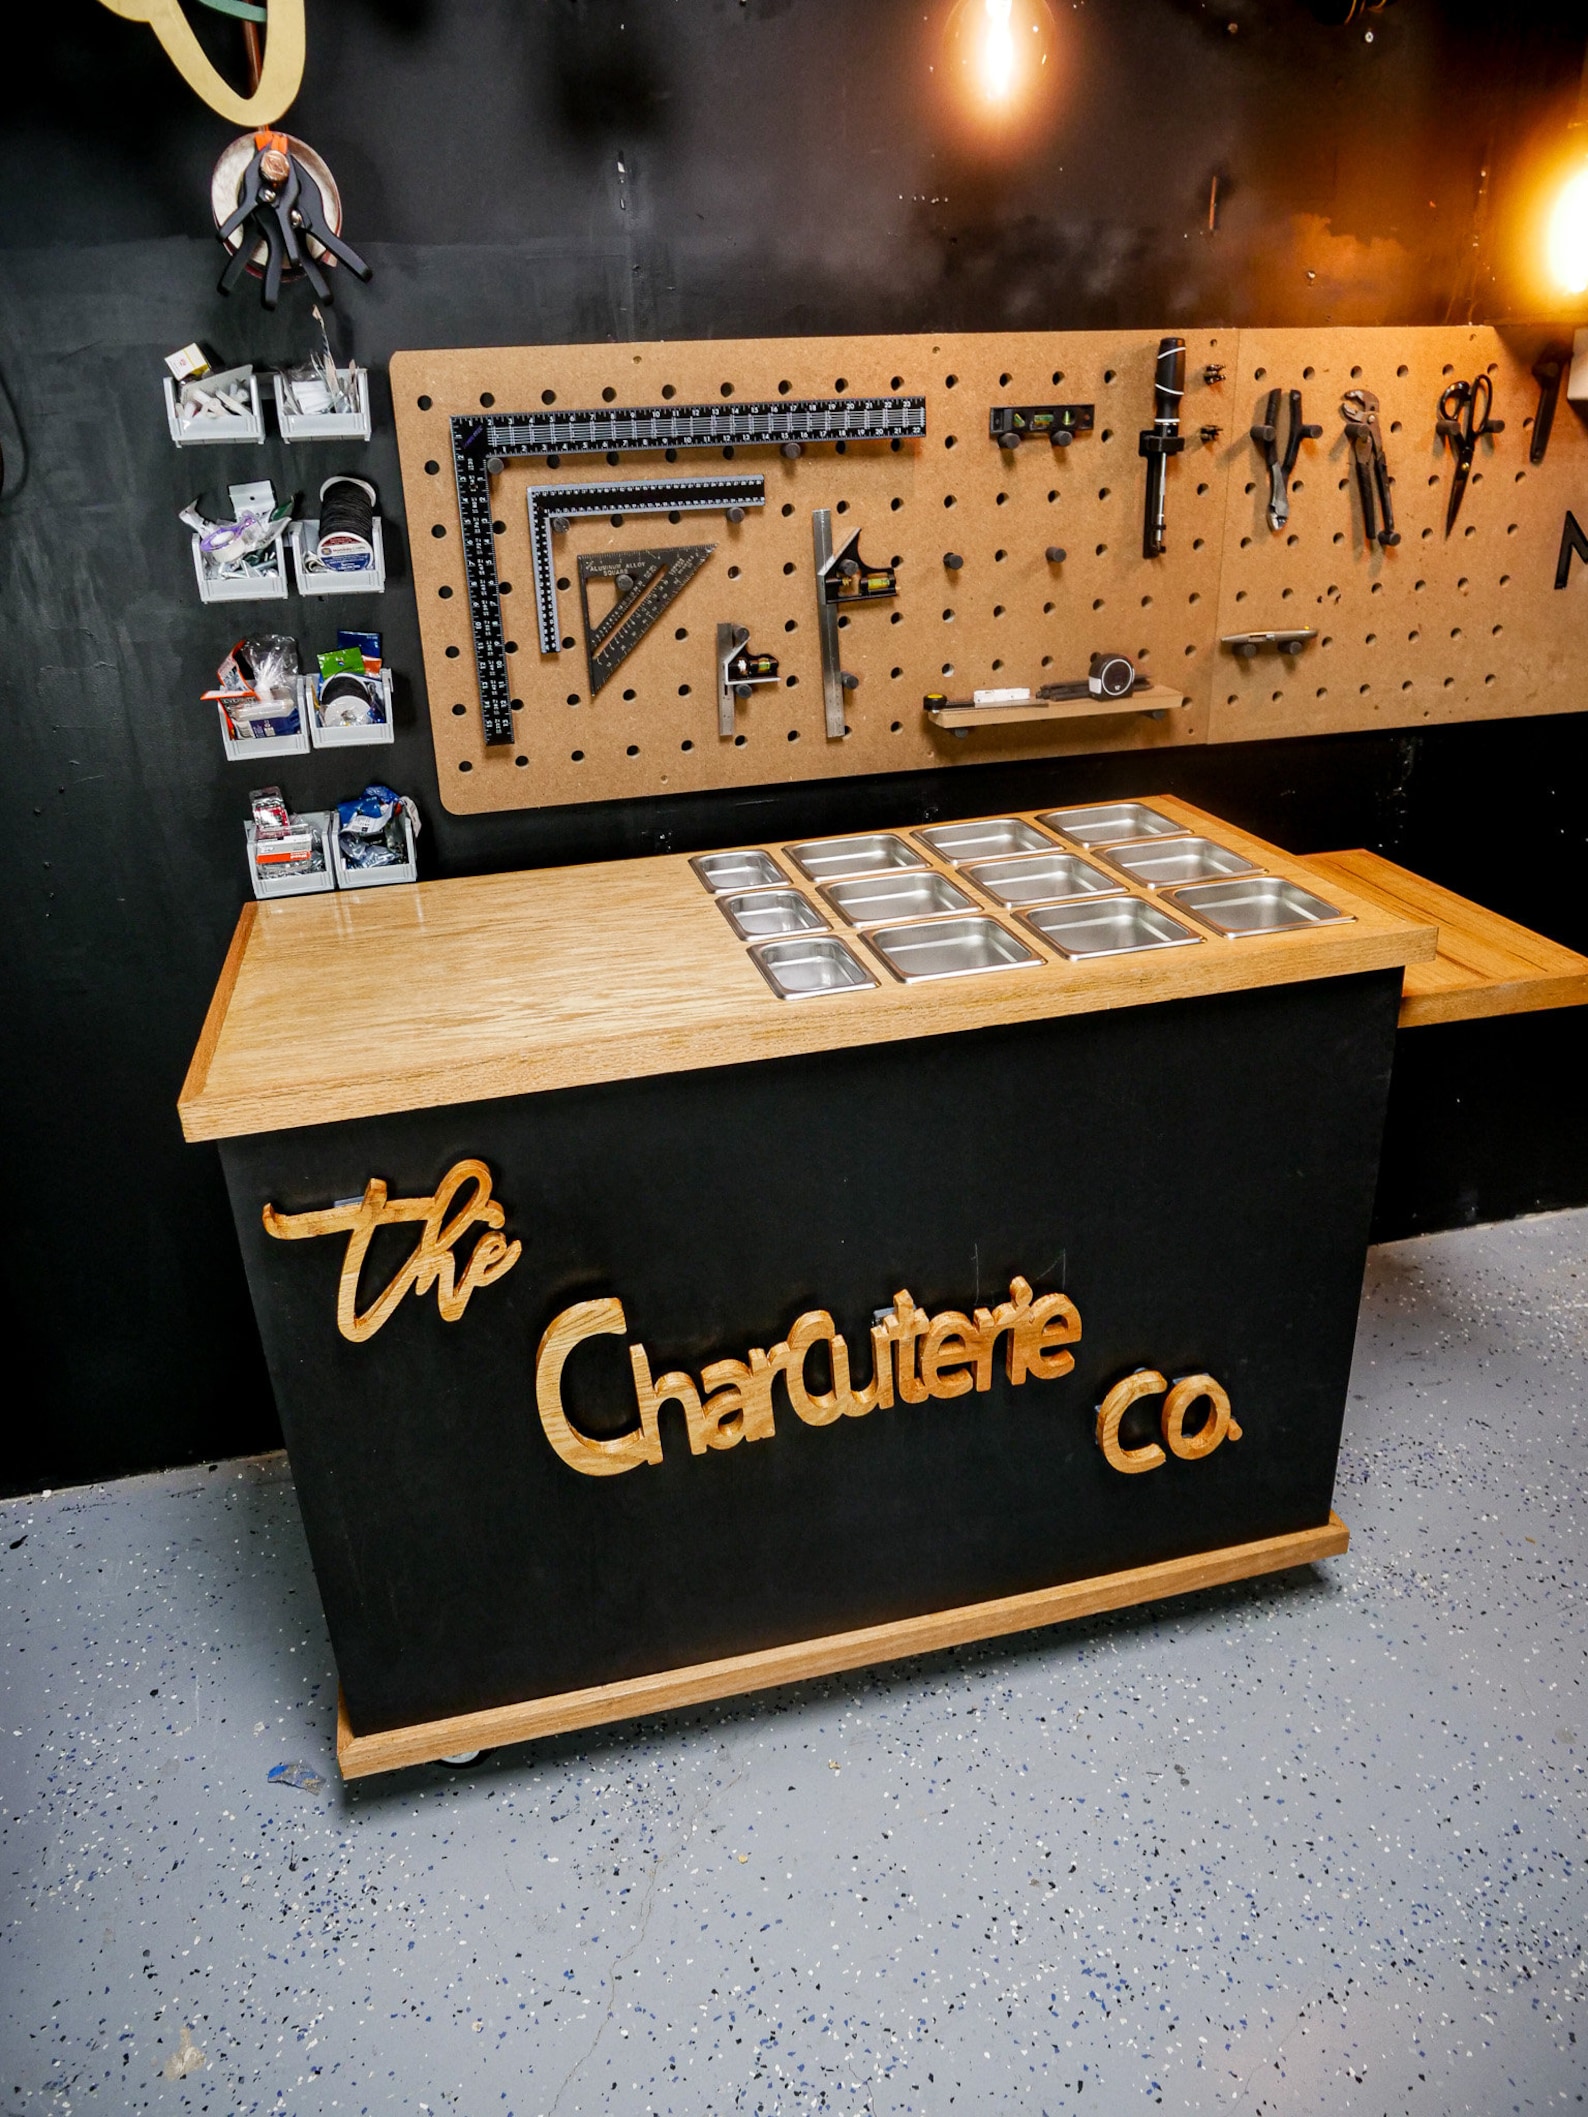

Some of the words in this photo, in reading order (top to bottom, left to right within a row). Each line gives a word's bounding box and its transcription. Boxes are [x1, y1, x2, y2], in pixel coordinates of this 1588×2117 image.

[589, 563, 622, 572] ALUMINUM
[625, 561, 646, 569] ALLOY
[536, 1276, 1082, 1477] Charcuterie
